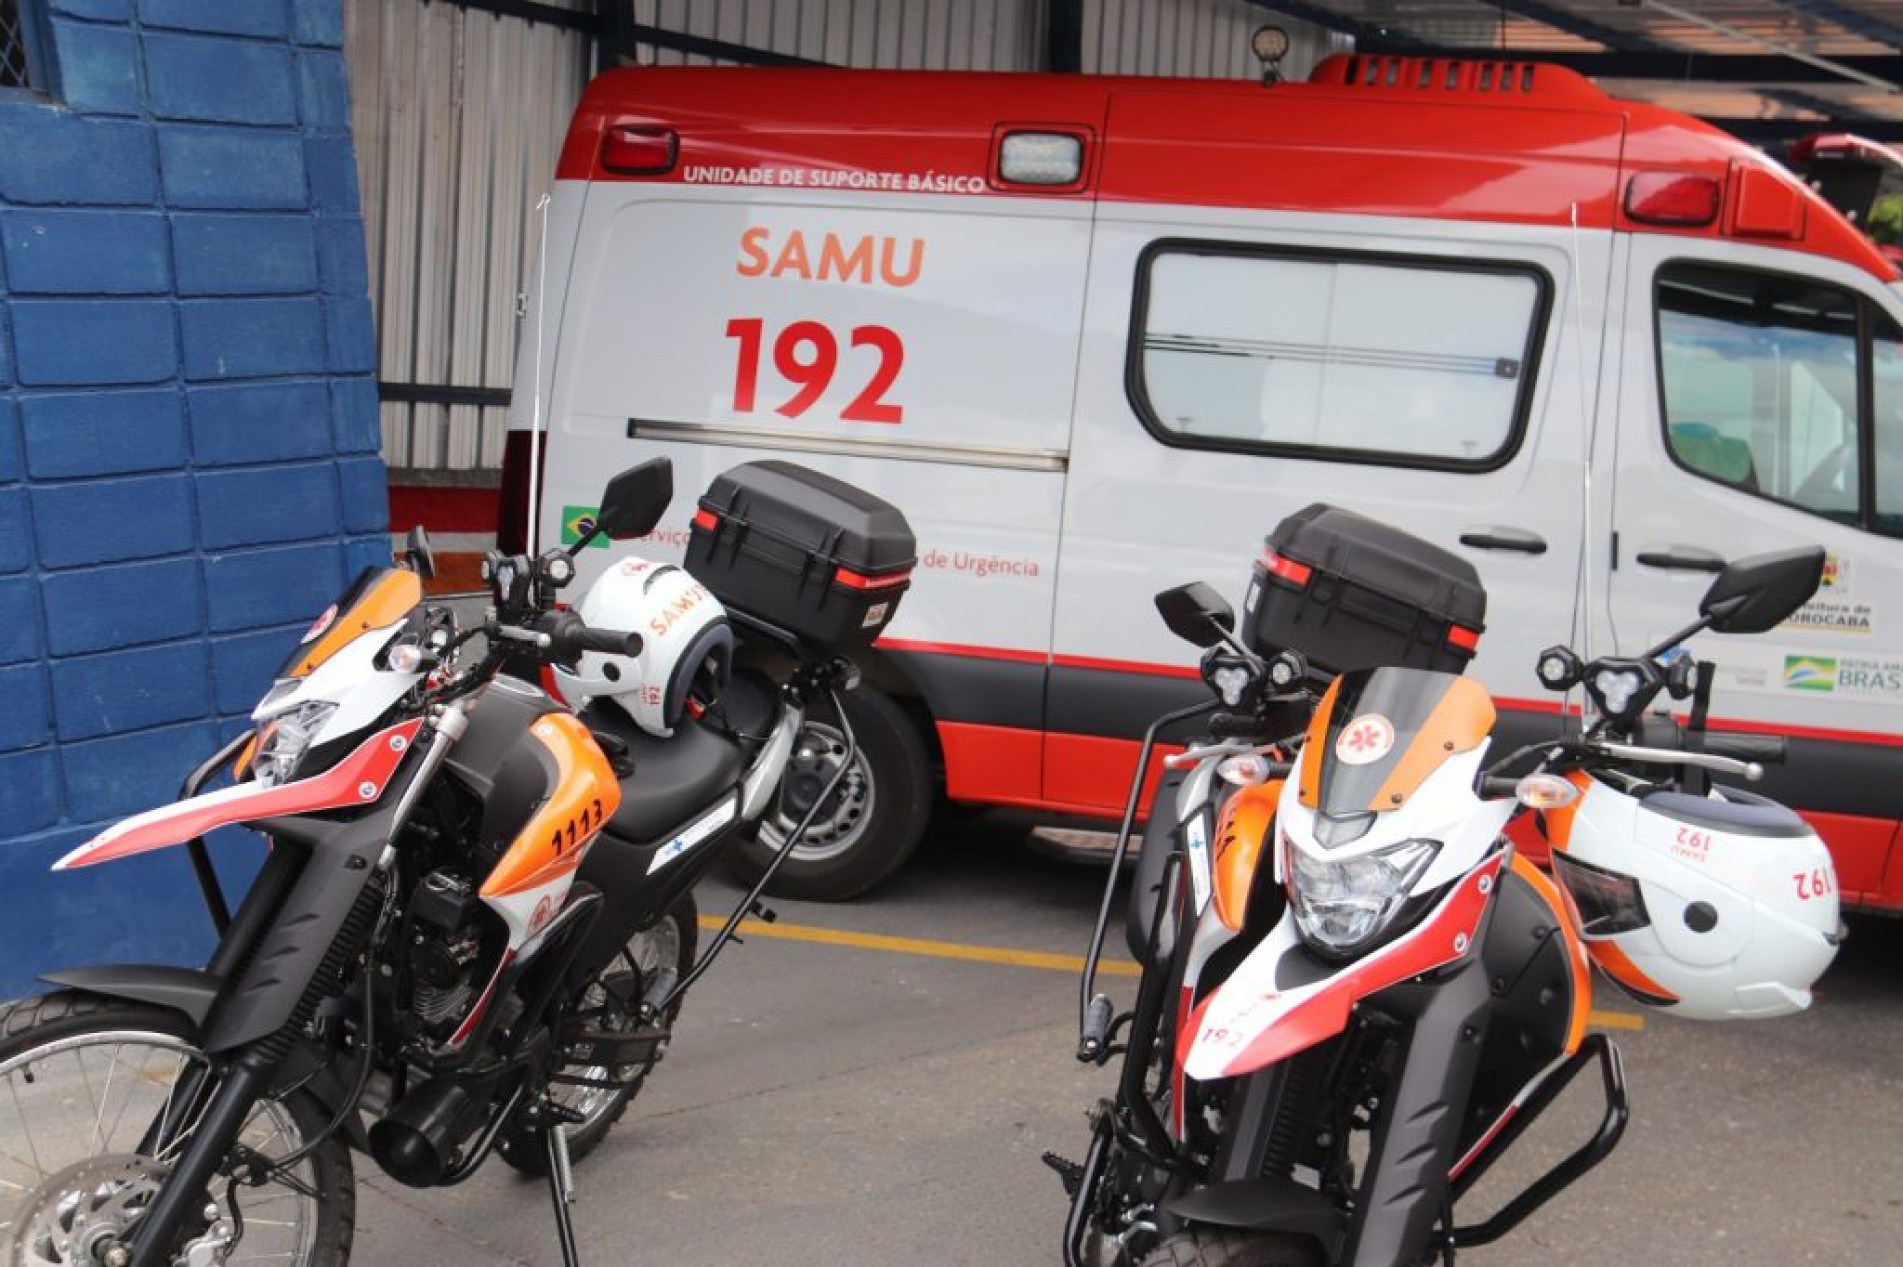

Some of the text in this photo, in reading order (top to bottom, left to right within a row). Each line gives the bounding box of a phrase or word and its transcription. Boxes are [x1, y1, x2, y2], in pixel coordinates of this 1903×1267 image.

[683, 165, 985, 193] UNIDADE DE SUPORTE BÁSICO
[735, 227, 925, 287] SAMU
[725, 317, 905, 424] 192
[923, 550, 947, 569] de
[954, 552, 1039, 577] Urgência
[1788, 612, 1870, 627] OROCABA
[1839, 669, 1902, 690] BRAS
[551, 799, 603, 857] 1113
[1676, 827, 1711, 852] 192
[1792, 866, 1831, 900] 192
